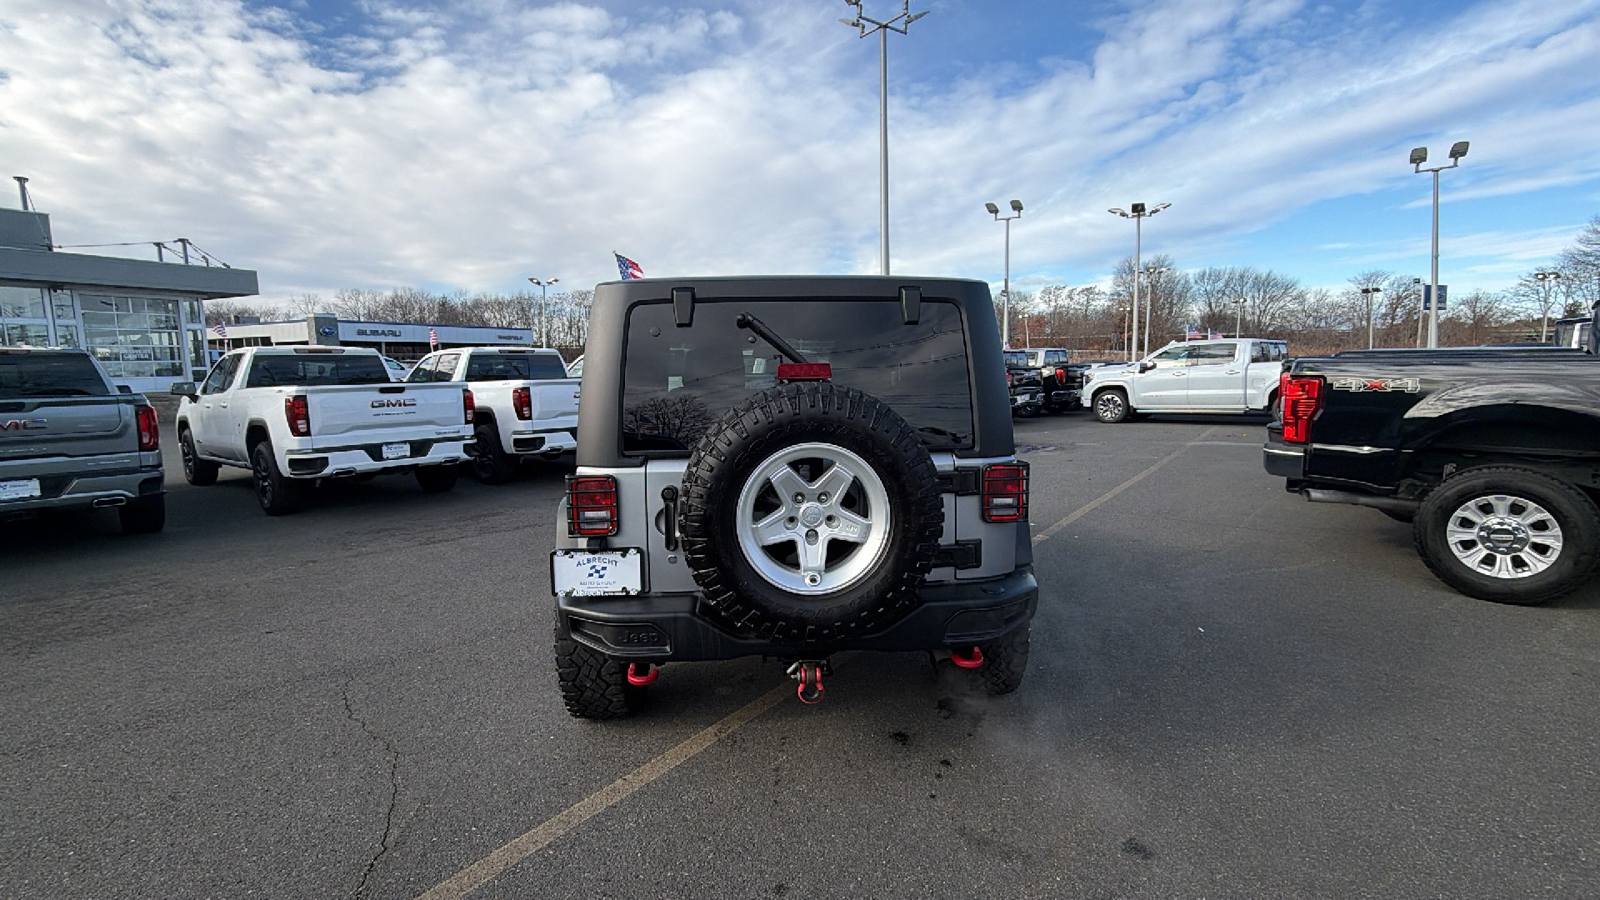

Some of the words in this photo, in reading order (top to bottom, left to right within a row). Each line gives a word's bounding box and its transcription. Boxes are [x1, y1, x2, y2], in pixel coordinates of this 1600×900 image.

[356, 329, 402, 338] SUBARU
[371, 398, 417, 409] GMC
[0, 418, 48, 431] MC
[576, 556, 618, 568] ALBRECHT
